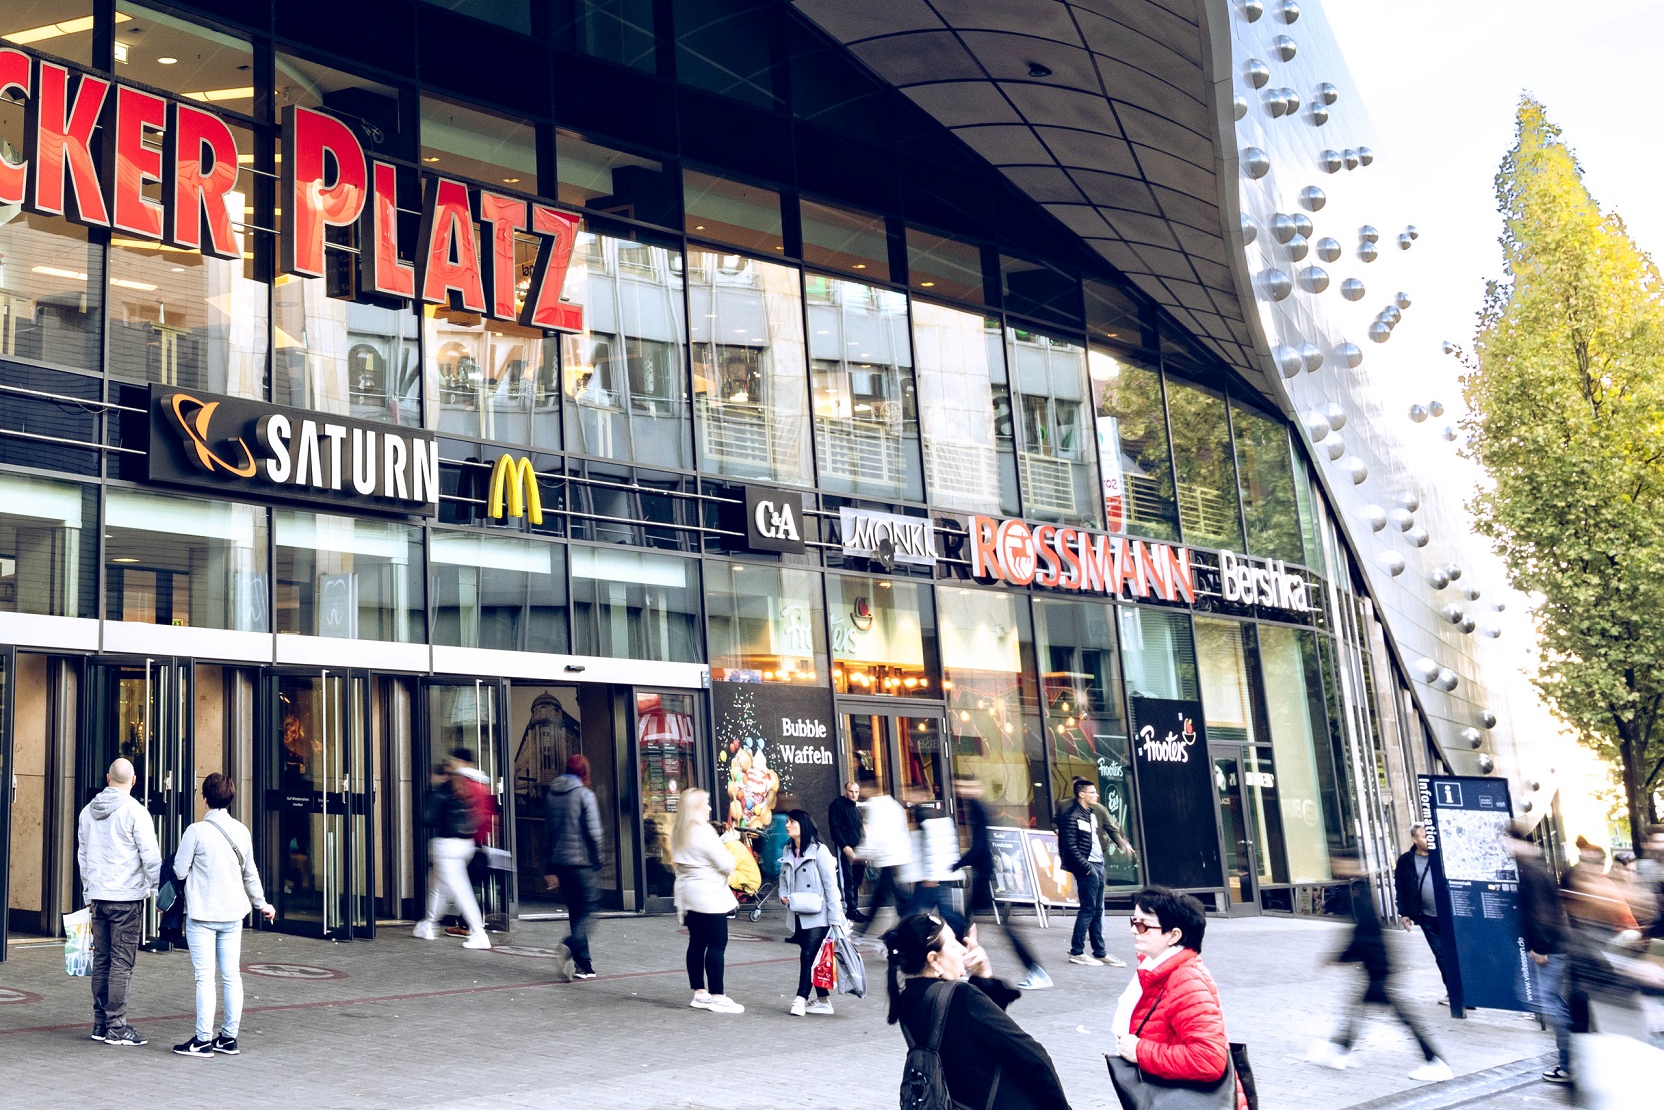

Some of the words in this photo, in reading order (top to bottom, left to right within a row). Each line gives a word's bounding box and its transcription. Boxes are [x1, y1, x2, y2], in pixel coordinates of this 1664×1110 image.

[280, 104, 582, 334] PLATZ
[262, 413, 439, 503] SATURN
[755, 500, 800, 540] C&A
[843, 516, 938, 557] MONKI
[968, 516, 1195, 603] ROSSMANN
[1220, 548, 1308, 612] Bershka
[782, 718, 826, 738] Bubble
[1140, 725, 1189, 762] Frooters
[779, 745, 833, 764] Waffeln
[1097, 758, 1123, 777] Frooters
[1419, 778, 1436, 850] Information
[1517, 936, 1532, 1001] www.visitessen.de
